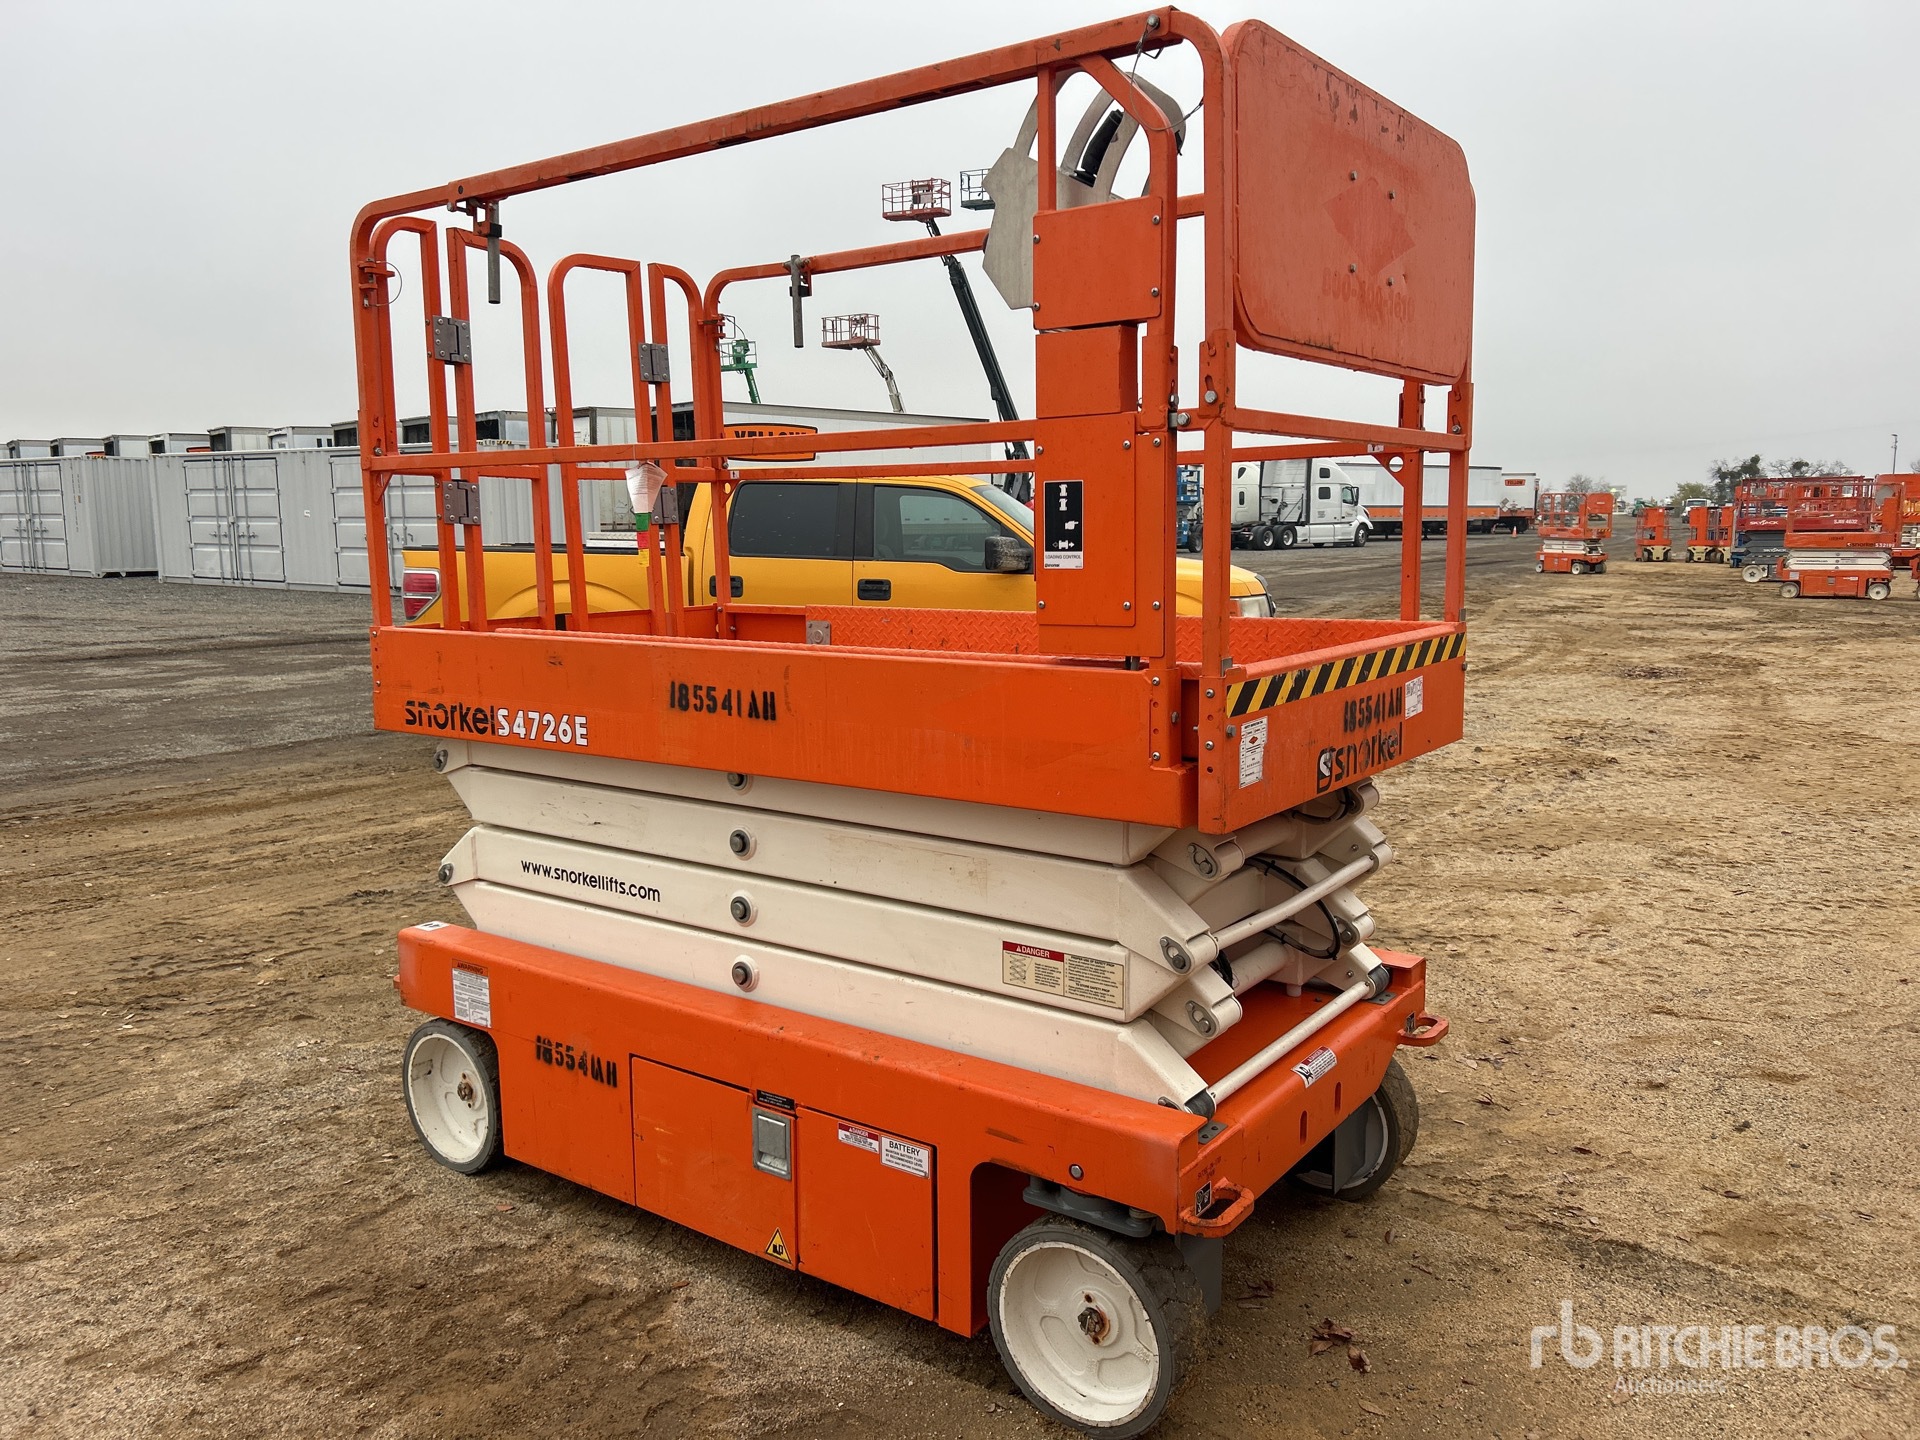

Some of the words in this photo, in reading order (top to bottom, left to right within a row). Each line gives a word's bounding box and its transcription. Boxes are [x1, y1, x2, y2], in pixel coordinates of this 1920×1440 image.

[404, 700, 496, 736] snorkel
[497, 707, 589, 747] S4726E
[521, 859, 661, 903] www.snorkellifts.com
[1021, 945, 1050, 958] DANGER
[889, 1140, 921, 1156] BATTERY
